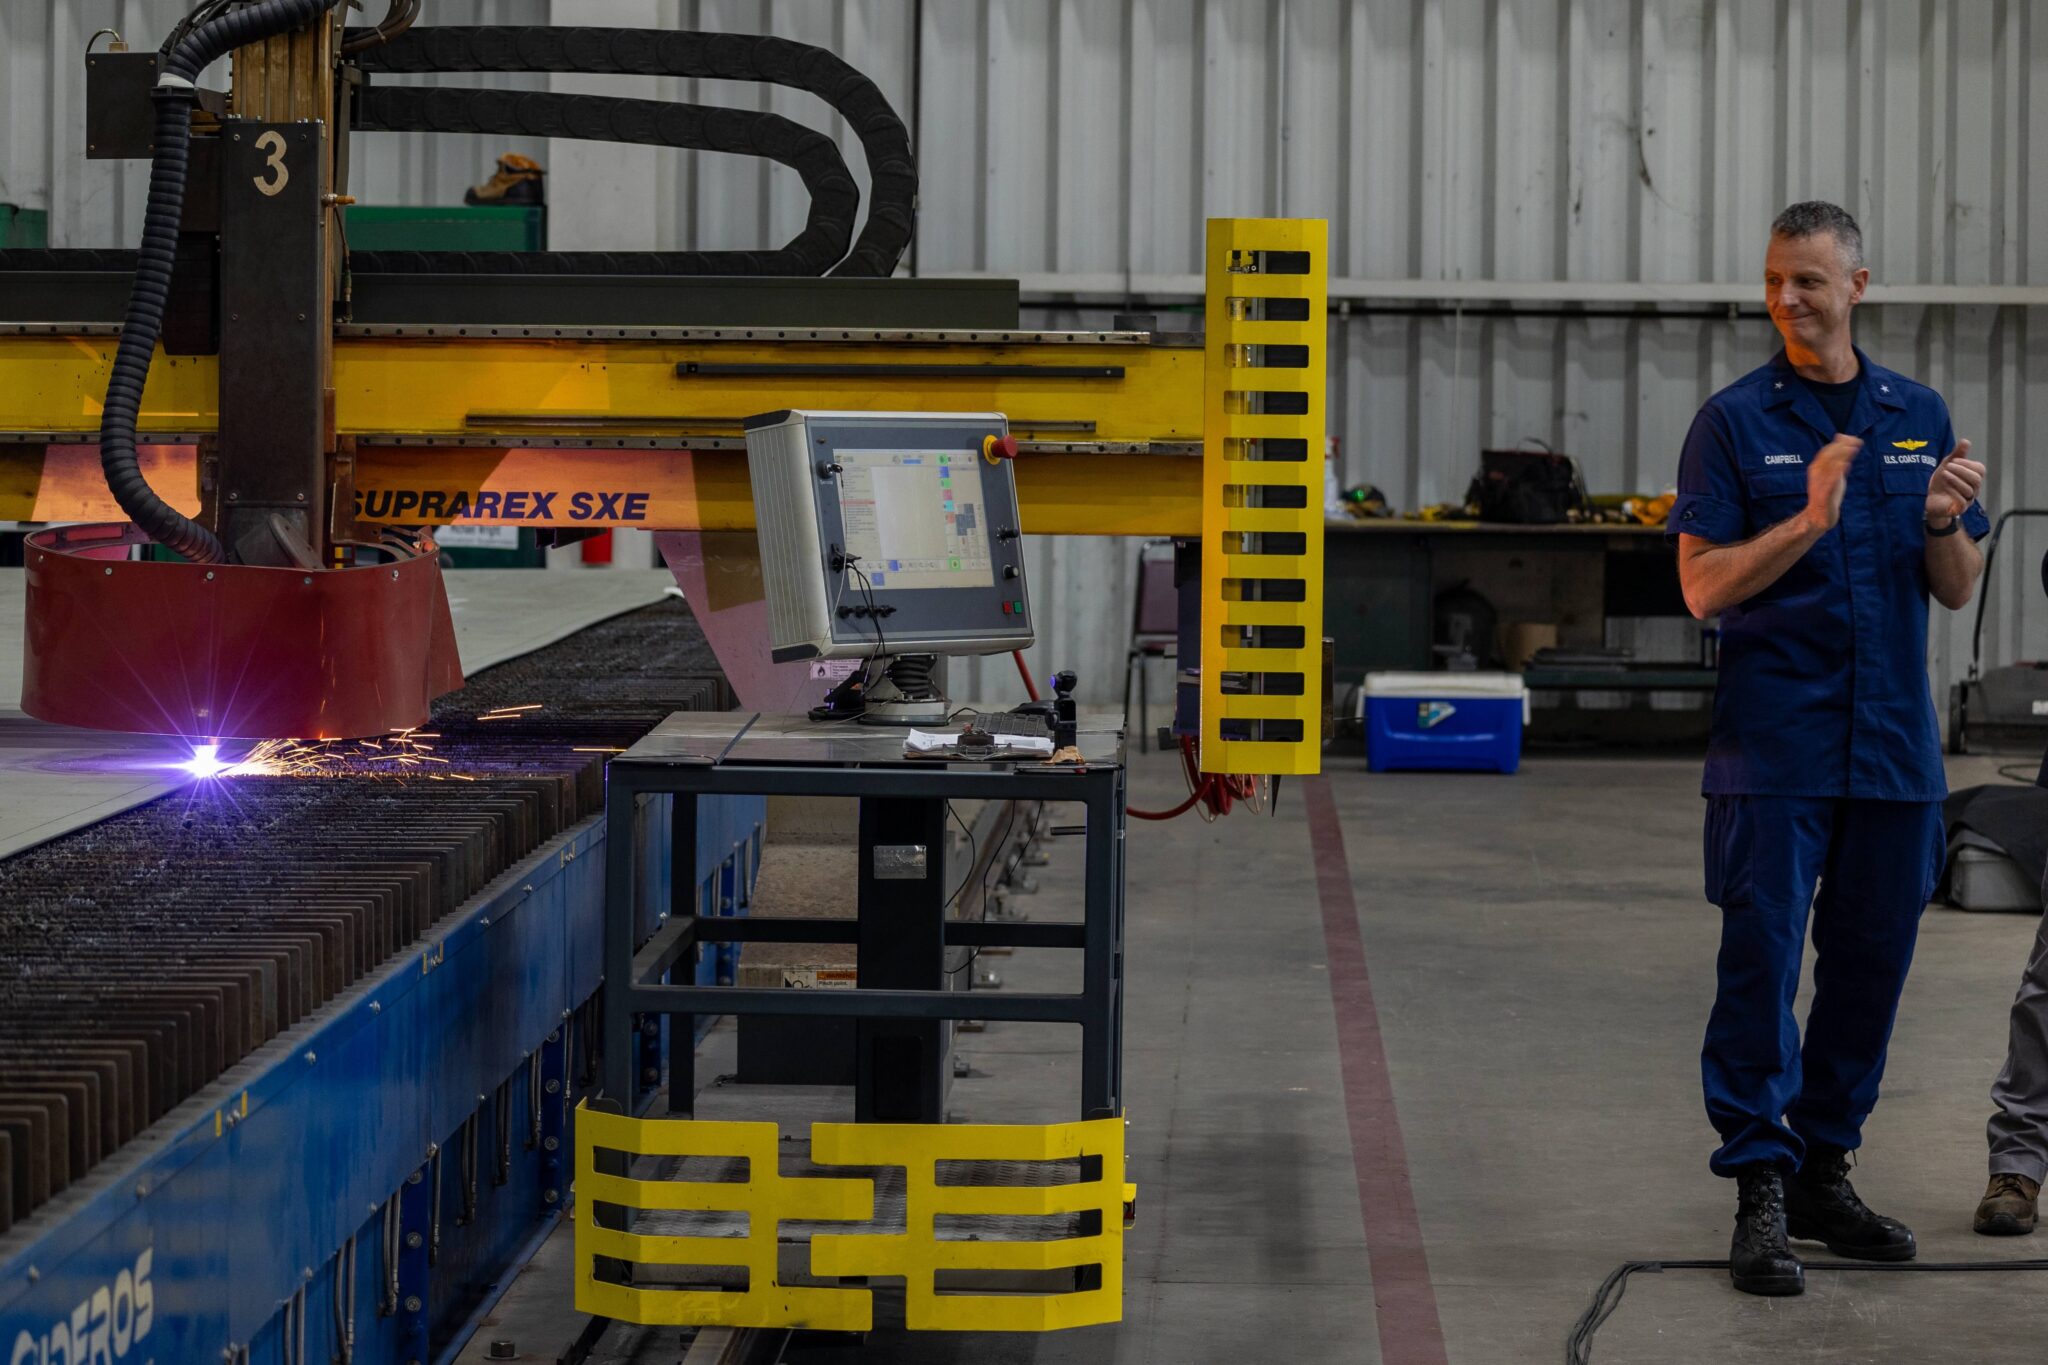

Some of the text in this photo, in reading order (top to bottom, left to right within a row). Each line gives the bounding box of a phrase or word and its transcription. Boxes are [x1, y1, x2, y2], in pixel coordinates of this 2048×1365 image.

[253, 130, 289, 197] 3
[1764, 454, 1804, 465] CAMPBELL
[1883, 455, 1899, 464] U.S.
[1898, 454, 1920, 464] COAST
[568, 491, 651, 521] SXE
